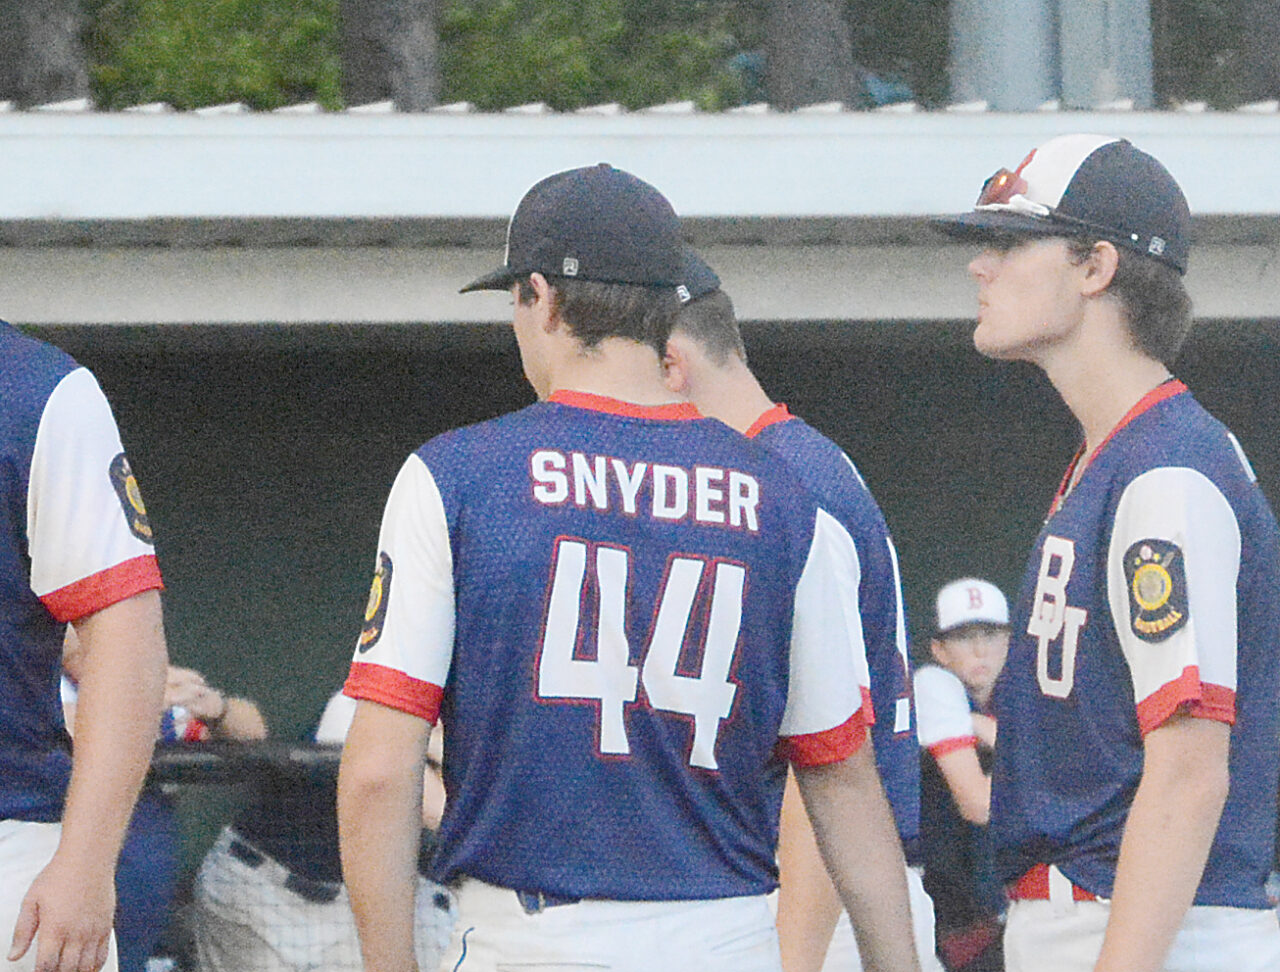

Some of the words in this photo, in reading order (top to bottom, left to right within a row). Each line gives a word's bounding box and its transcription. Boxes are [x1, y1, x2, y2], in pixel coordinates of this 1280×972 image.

[529, 448, 762, 534] SNYDER
[966, 587, 984, 610] B
[536, 537, 748, 772] 44
